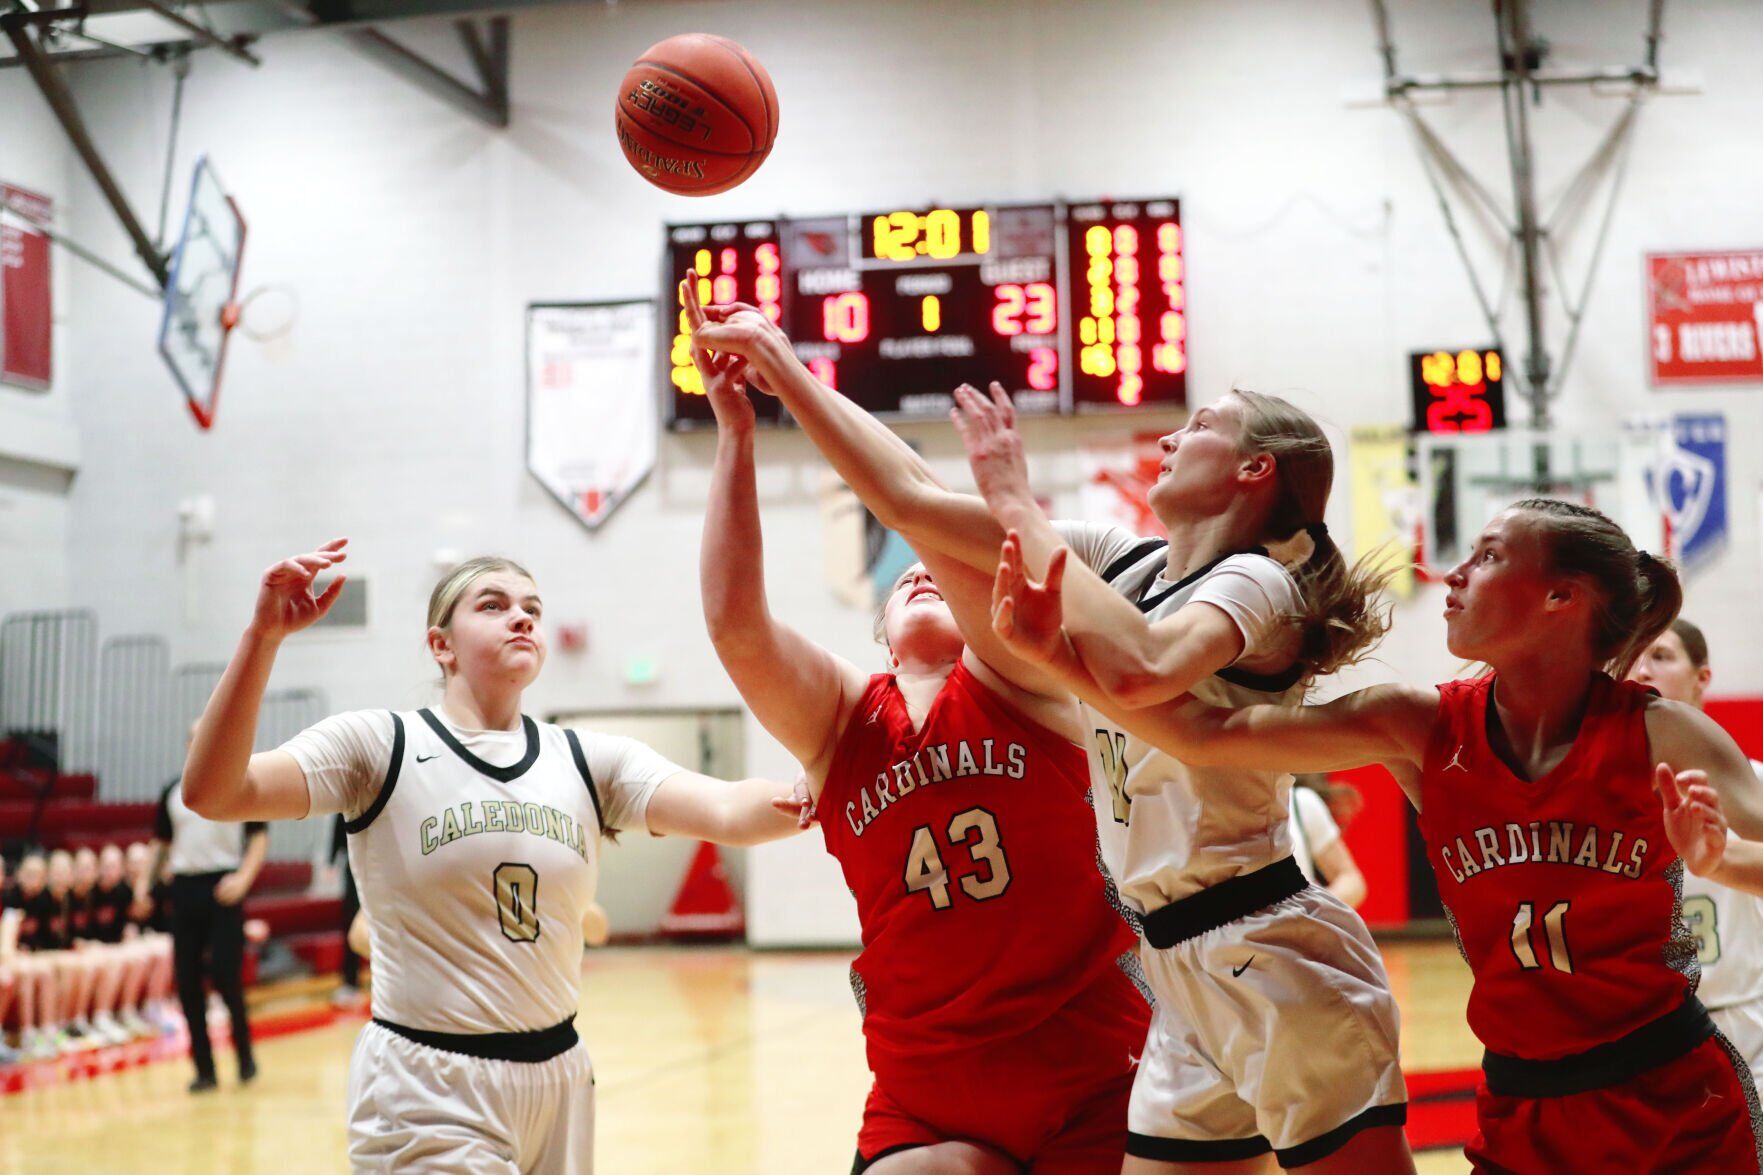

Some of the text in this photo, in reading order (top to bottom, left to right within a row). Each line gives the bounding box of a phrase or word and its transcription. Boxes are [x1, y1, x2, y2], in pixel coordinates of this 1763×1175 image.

[627, 87, 712, 140] LEGACY
[873, 209, 990, 261] 12:01
[823, 291, 869, 343] 10
[922, 295, 940, 332] 1
[992, 282, 1057, 336] 23
[1027, 347, 1057, 390] 2
[845, 738, 1027, 837] CARDINALS
[420, 801, 589, 864] CALEDONIA
[903, 805, 1013, 911] 43
[1441, 821, 1648, 885] CARDINALS
[493, 862, 540, 943] 0
[1510, 900, 1572, 975] 11
